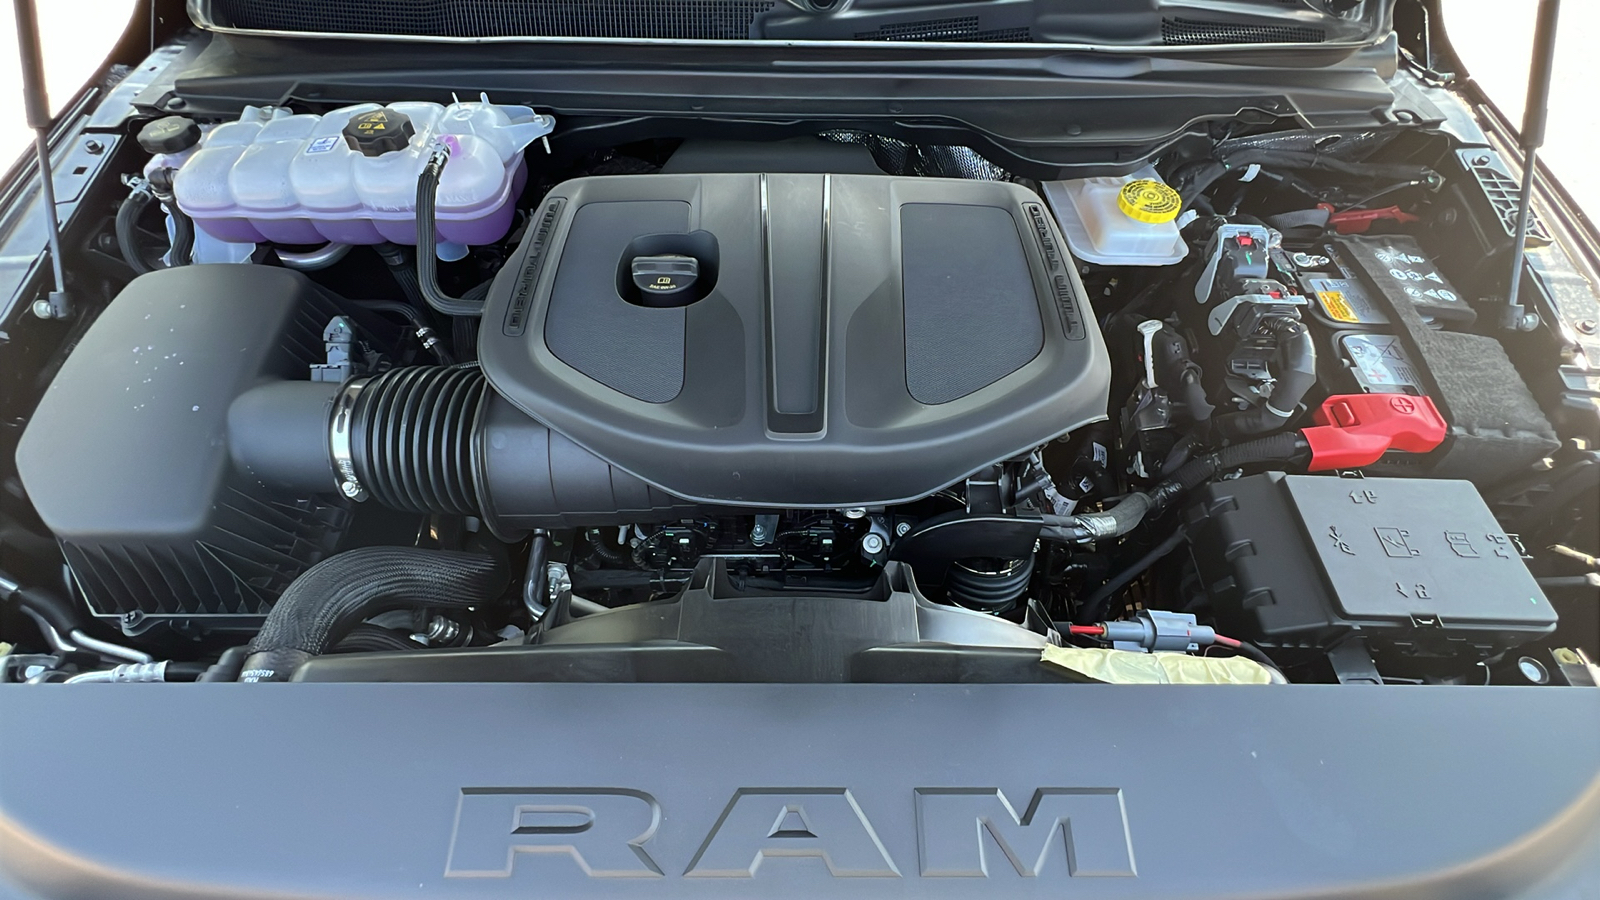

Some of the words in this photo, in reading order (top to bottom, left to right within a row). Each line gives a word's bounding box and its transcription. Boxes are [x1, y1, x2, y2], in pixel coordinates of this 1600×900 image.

[1029, 204, 1060, 272] TURBO
[509, 251, 543, 328] TURBO
[443, 786, 1140, 878] RAM
